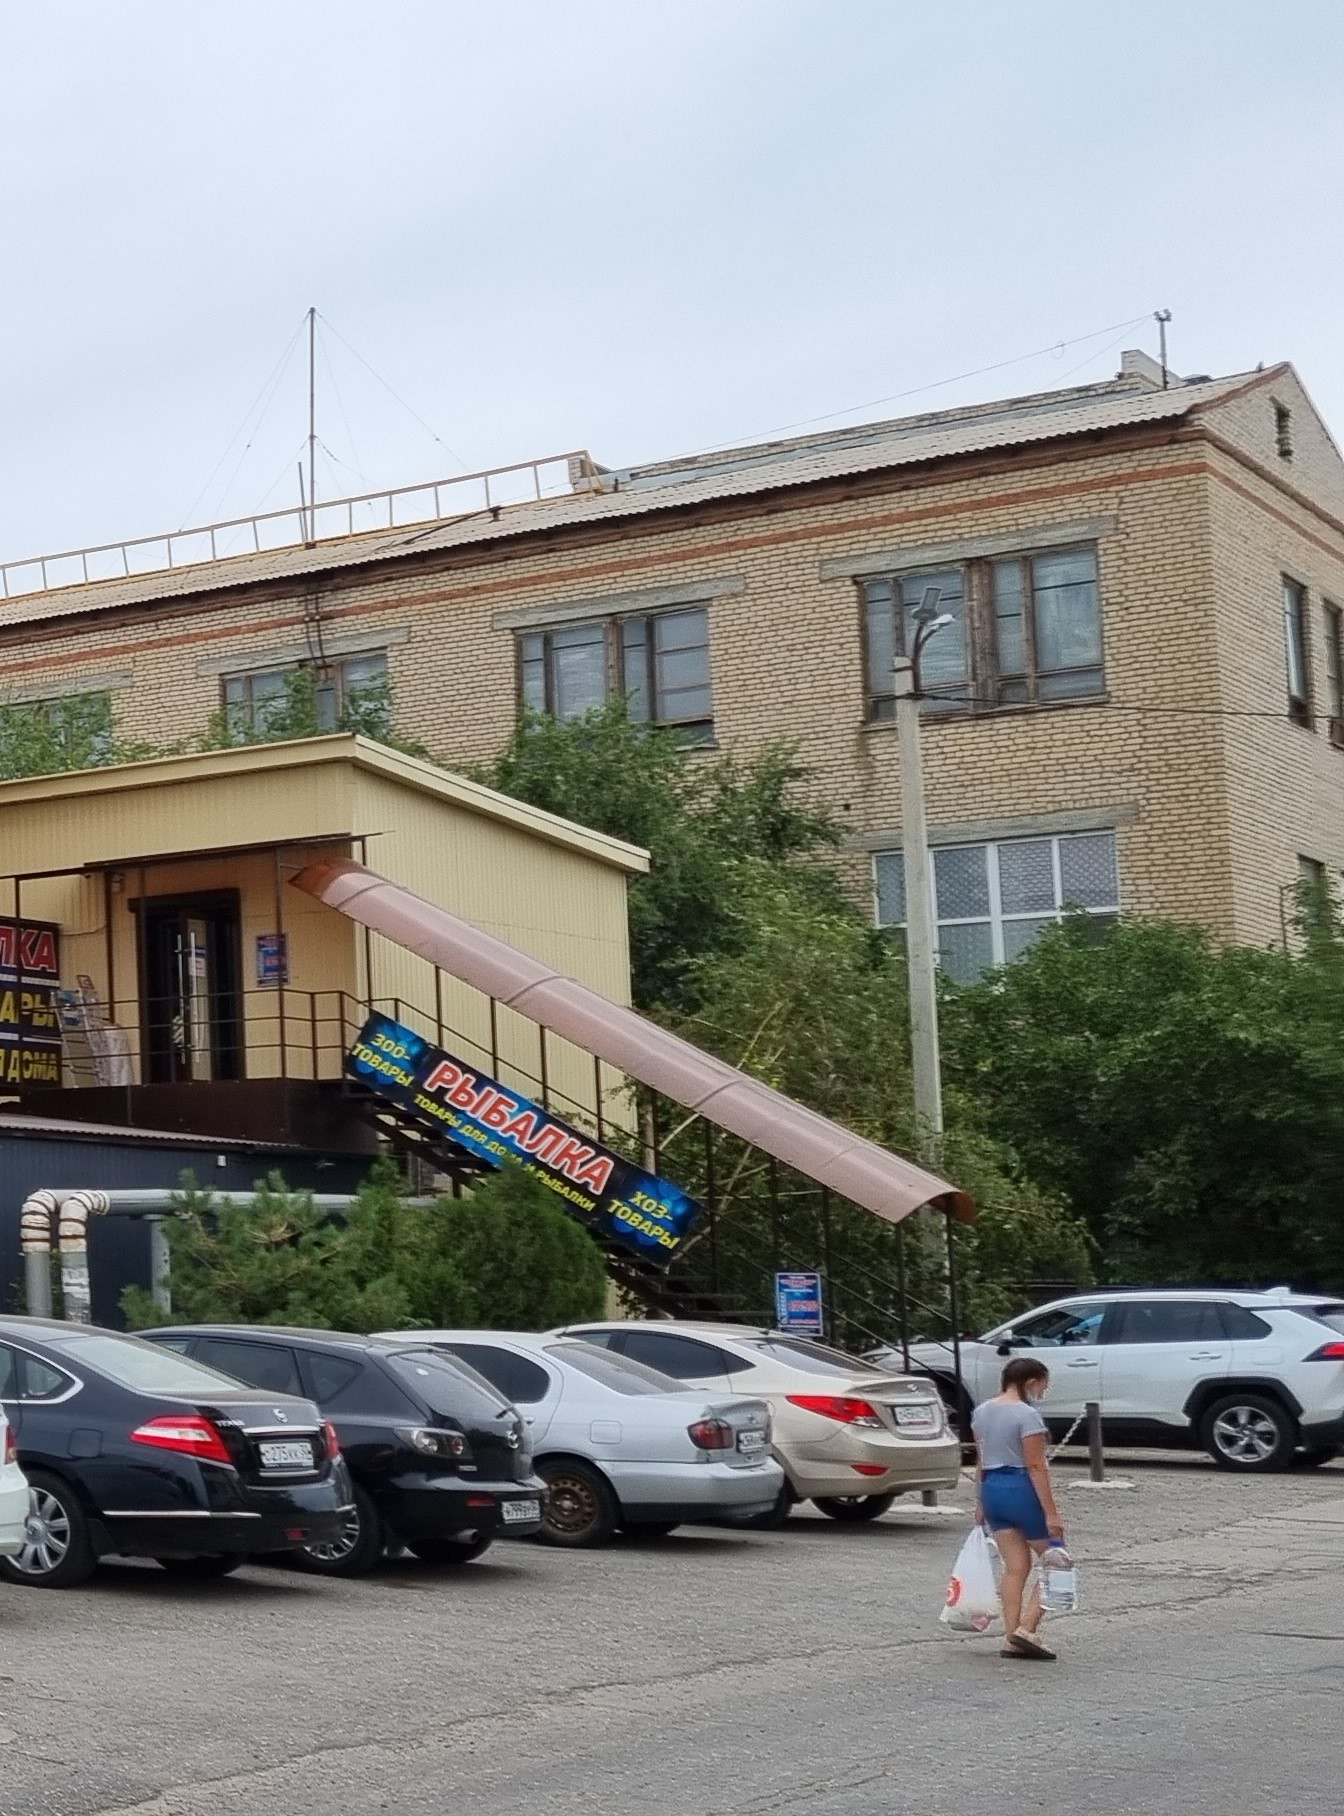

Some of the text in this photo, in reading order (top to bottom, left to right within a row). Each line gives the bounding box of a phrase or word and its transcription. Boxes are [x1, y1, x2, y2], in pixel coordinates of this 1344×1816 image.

[351, 1043, 415, 1087] ТОВАРЫ
[413, 1093, 462, 1128] ТОВАРЫ
[458, 1124, 488, 1145] ДЛЯ
[535, 1170, 596, 1212] РЫБАЛКИ
[422, 1059, 615, 1196] РЫБАЛКА
[607, 1199, 680, 1249] ТОВАРЫ
[628, 1191, 673, 1220] ХОЗ-
